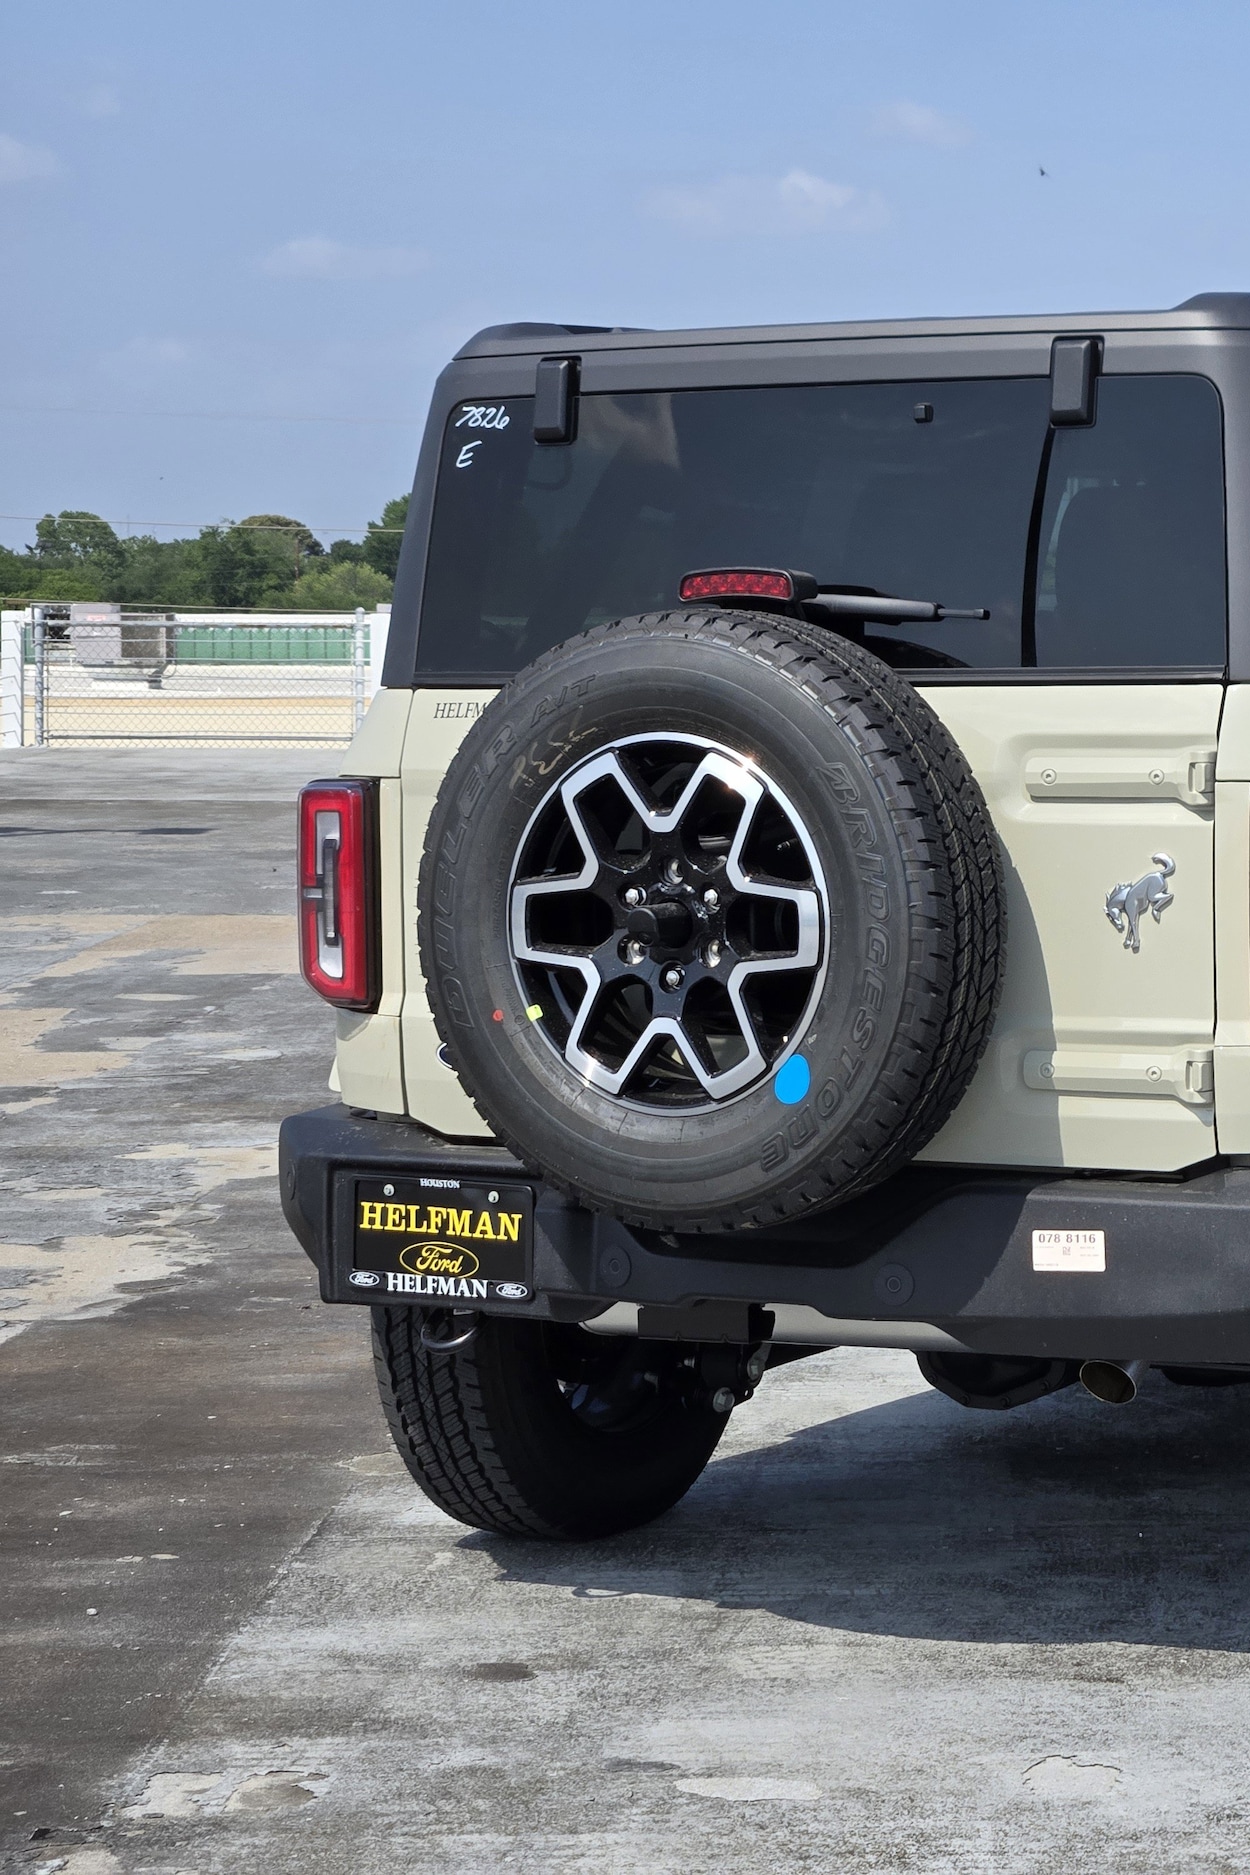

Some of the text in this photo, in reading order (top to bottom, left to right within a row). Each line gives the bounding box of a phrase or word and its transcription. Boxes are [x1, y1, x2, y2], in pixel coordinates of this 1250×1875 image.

[455, 405, 512, 430] 7826
[455, 440, 483, 468] E
[760, 761, 892, 1173] BRIDGESTONE
[419, 1178, 461, 1189] HOUSTON
[359, 1201, 523, 1242] HELFMAN
[1038, 1233, 1096, 1244] 078 8116
[415, 1245, 463, 1274] Ford
[354, 1272, 523, 1298] Ford HELFMAN Ford
